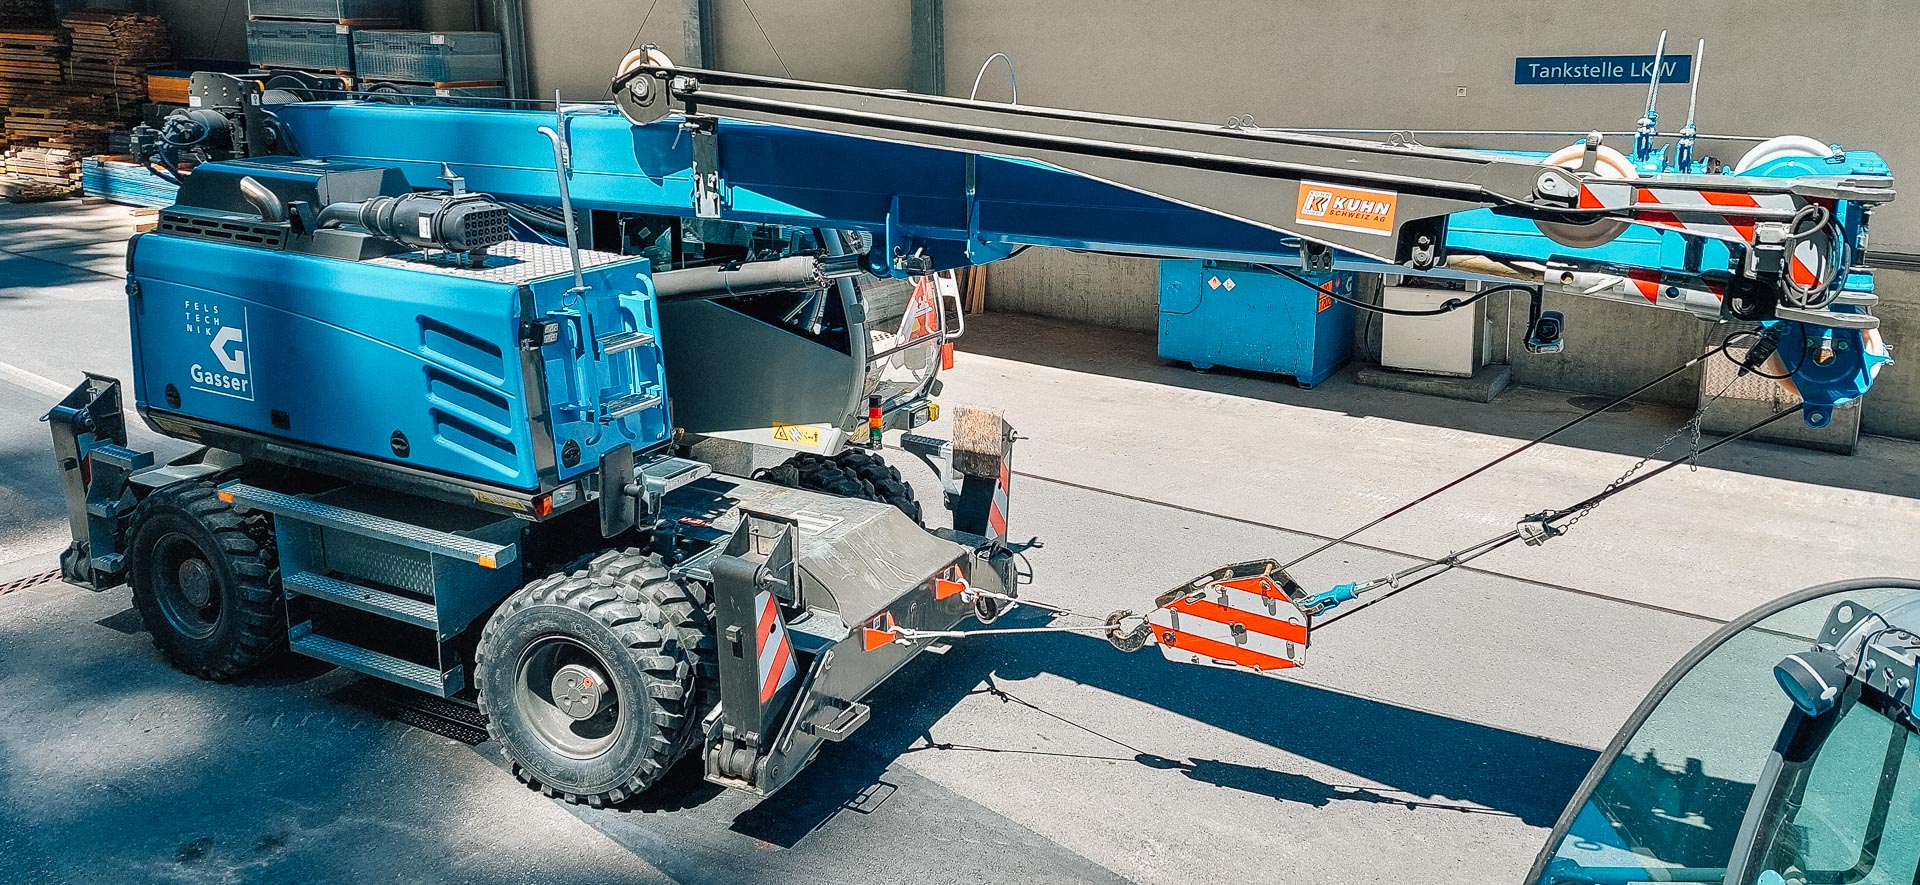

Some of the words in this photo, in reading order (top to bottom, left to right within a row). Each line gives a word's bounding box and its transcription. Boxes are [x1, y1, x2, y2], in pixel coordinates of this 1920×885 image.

[1528, 62, 1624, 78] Tankstelle
[1630, 62, 1677, 77] LKW
[1333, 196, 1391, 216] KUHN
[1329, 209, 1370, 221] SCHWEIZ
[185, 300, 219, 314] FELS
[185, 312, 220, 326] TECH
[186, 323, 212, 336] NIK
[190, 363, 249, 392] Gasser
